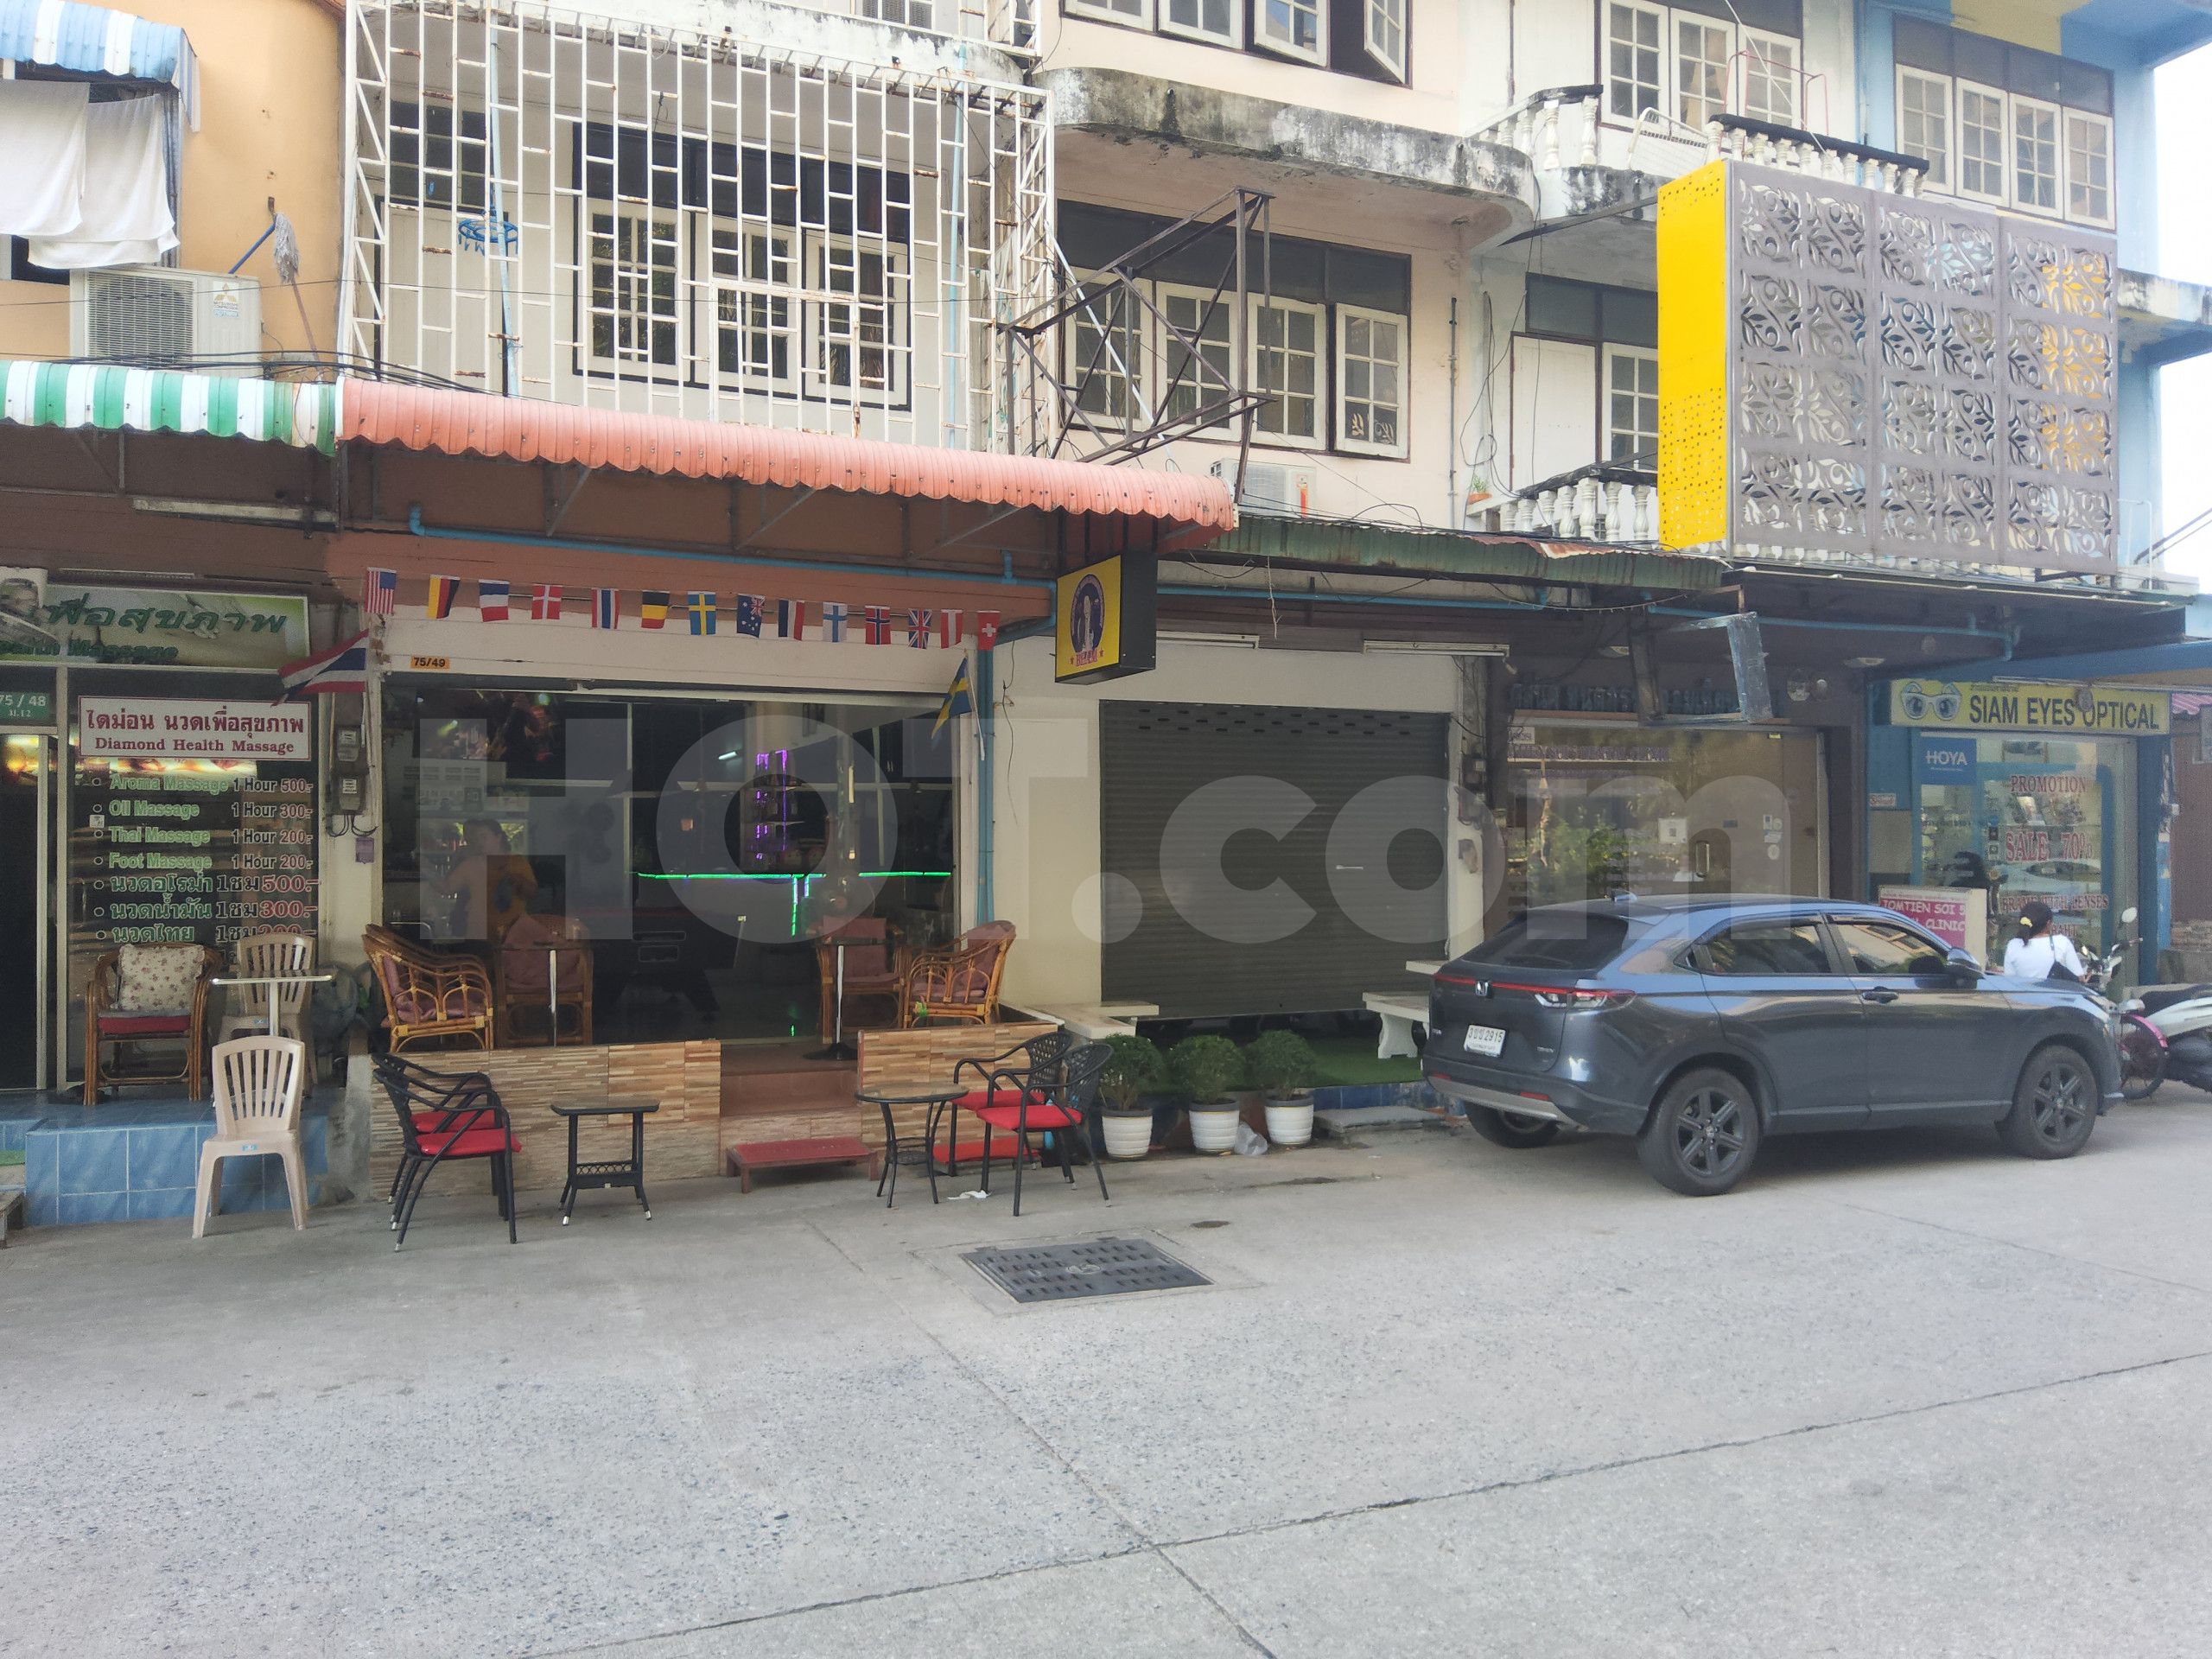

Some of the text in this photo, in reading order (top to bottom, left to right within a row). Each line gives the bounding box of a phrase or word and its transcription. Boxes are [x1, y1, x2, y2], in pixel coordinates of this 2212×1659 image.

[413, 657, 447, 668] 75/49
[164, 705, 304, 738] นวดเพื่อสุขภาพ
[1969, 695, 2159, 730] SIAM EYES OPTICAL
[95, 737, 294, 754] Diamond Health Massage
[1925, 750, 1968, 766] HOYA
[110, 773, 161, 790] Aroma
[163, 774, 228, 795] Massage
[233, 777, 240, 792] 1
[244, 777, 277, 792] Hour
[2010, 775, 2088, 793] PROMOTION
[109, 799, 131, 817] Oil
[134, 800, 200, 820] Massage
[232, 802, 239, 817] 1
[243, 802, 276, 817] Hour
[108, 825, 143, 842] Thai
[145, 826, 211, 847] Massage
[232, 829, 239, 844] 1
[243, 828, 276, 844] Hour
[2005, 830, 2094, 862] SALE 70%
[109, 852, 145, 868] Foot
[147, 853, 212, 873] Massage
[232, 854, 239, 869] 1
[243, 854, 276, 869] Hour
[110, 871, 213, 893] นวดอโรม่า
[110, 893, 212, 918] นวดน้ำมัน
[1934, 903, 1955, 915] SOI
[112, 923, 195, 943] นวดไทย
[1484, 1031, 1503, 1044] 2915
